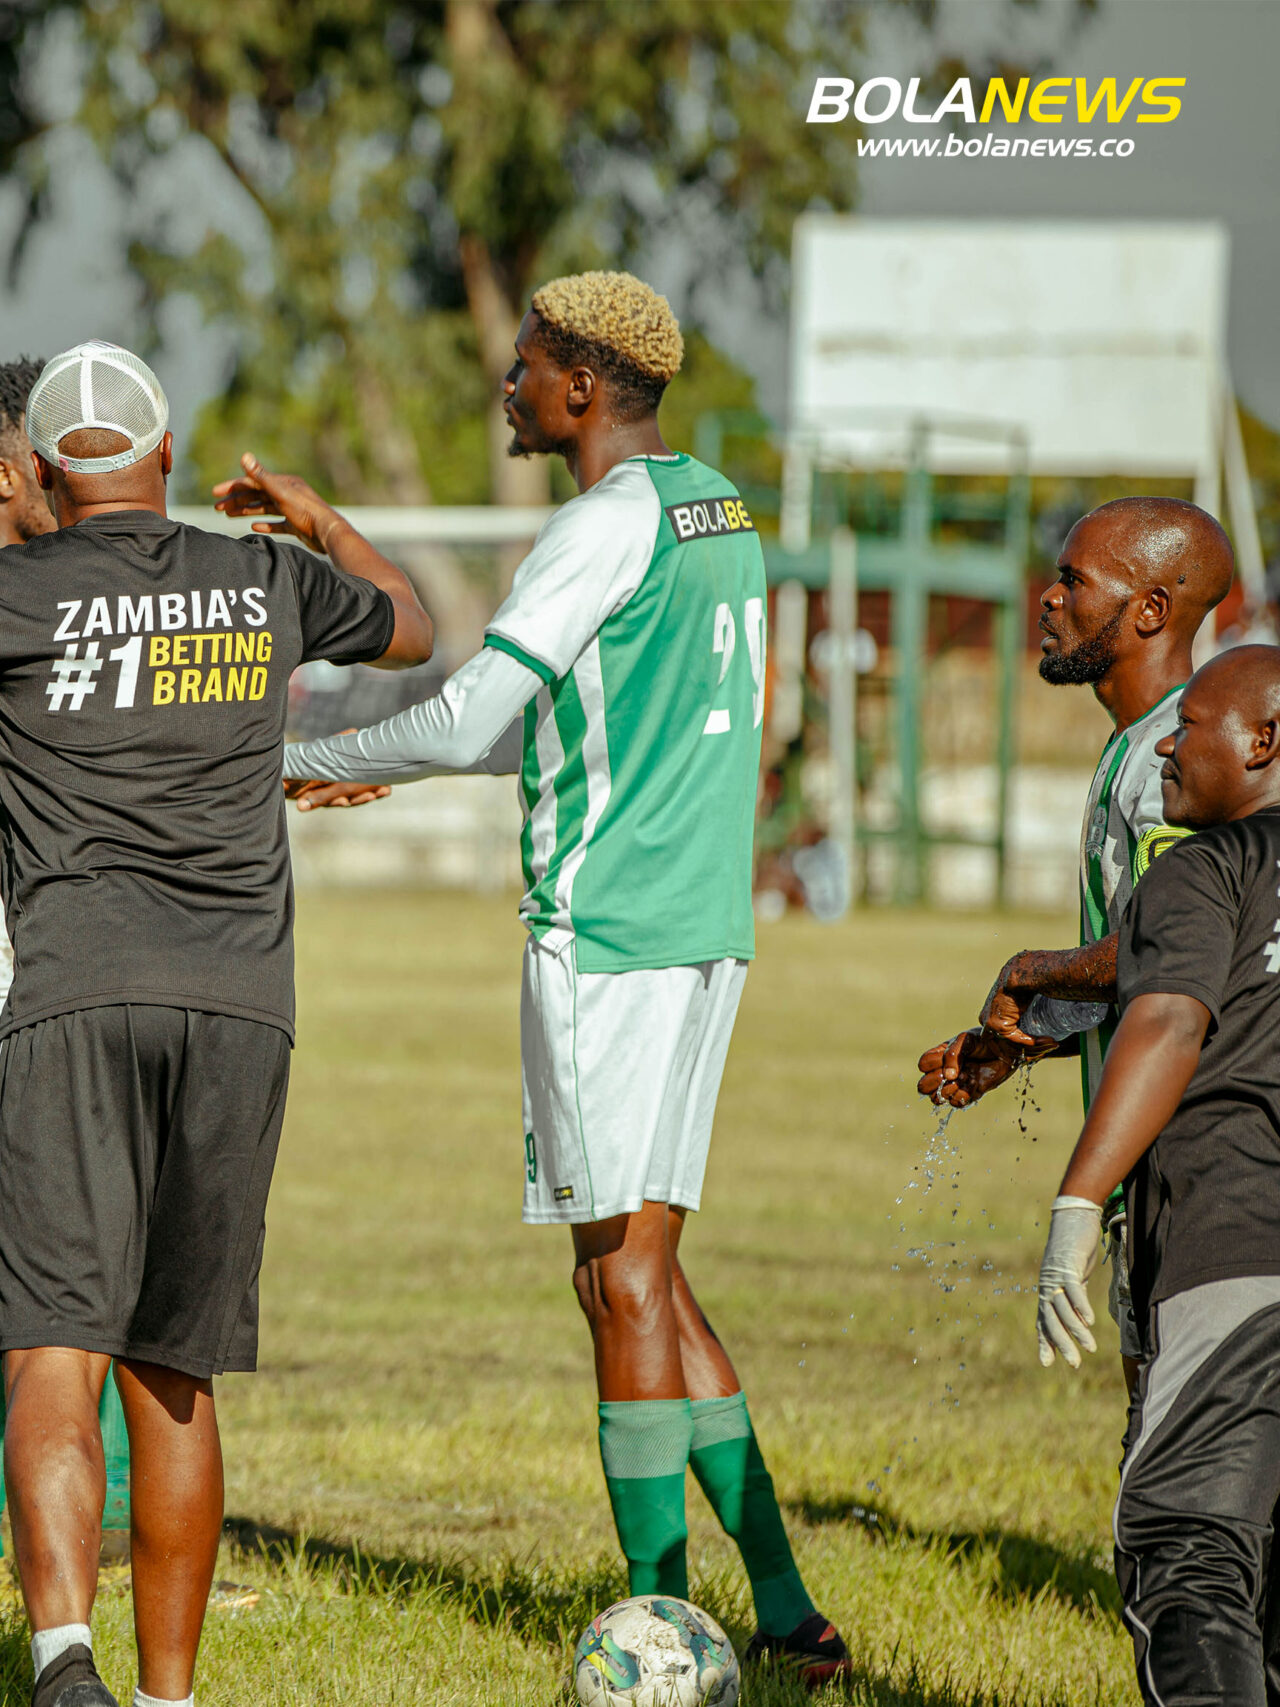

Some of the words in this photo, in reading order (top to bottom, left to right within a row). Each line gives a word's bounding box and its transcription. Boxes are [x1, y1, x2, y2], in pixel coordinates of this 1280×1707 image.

[53, 587, 268, 642] ZAMBIA'S
[148, 631, 273, 667] BETTING
[45, 636, 143, 711] #1
[152, 666, 268, 706] BRAND
